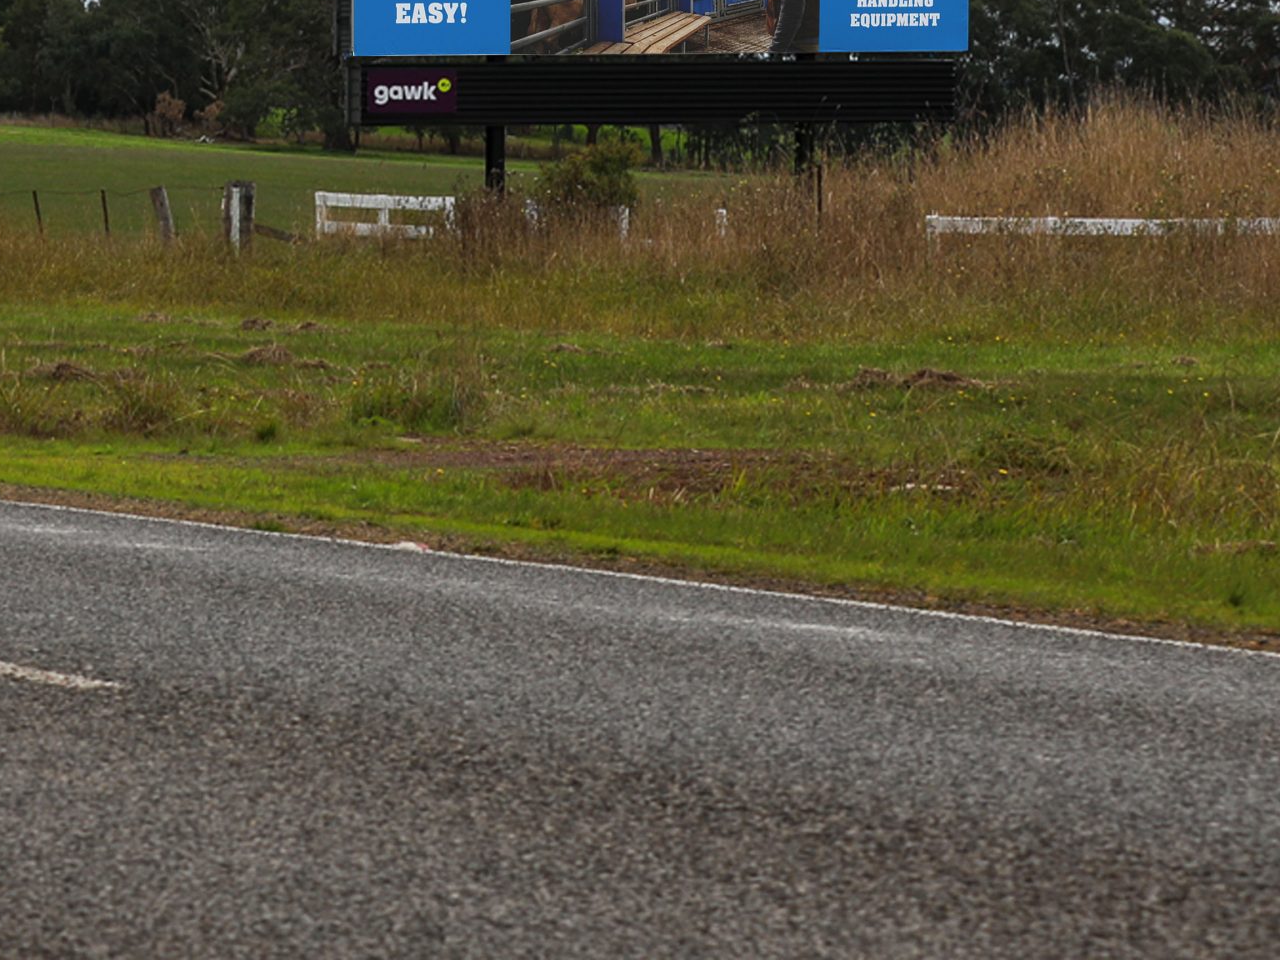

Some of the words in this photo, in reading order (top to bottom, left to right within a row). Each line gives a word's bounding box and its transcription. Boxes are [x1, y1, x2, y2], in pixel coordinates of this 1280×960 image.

[395, 2, 468, 24] EASY!
[850, 12, 941, 29] EQUIPMENT
[373, 81, 437, 105] gawk
